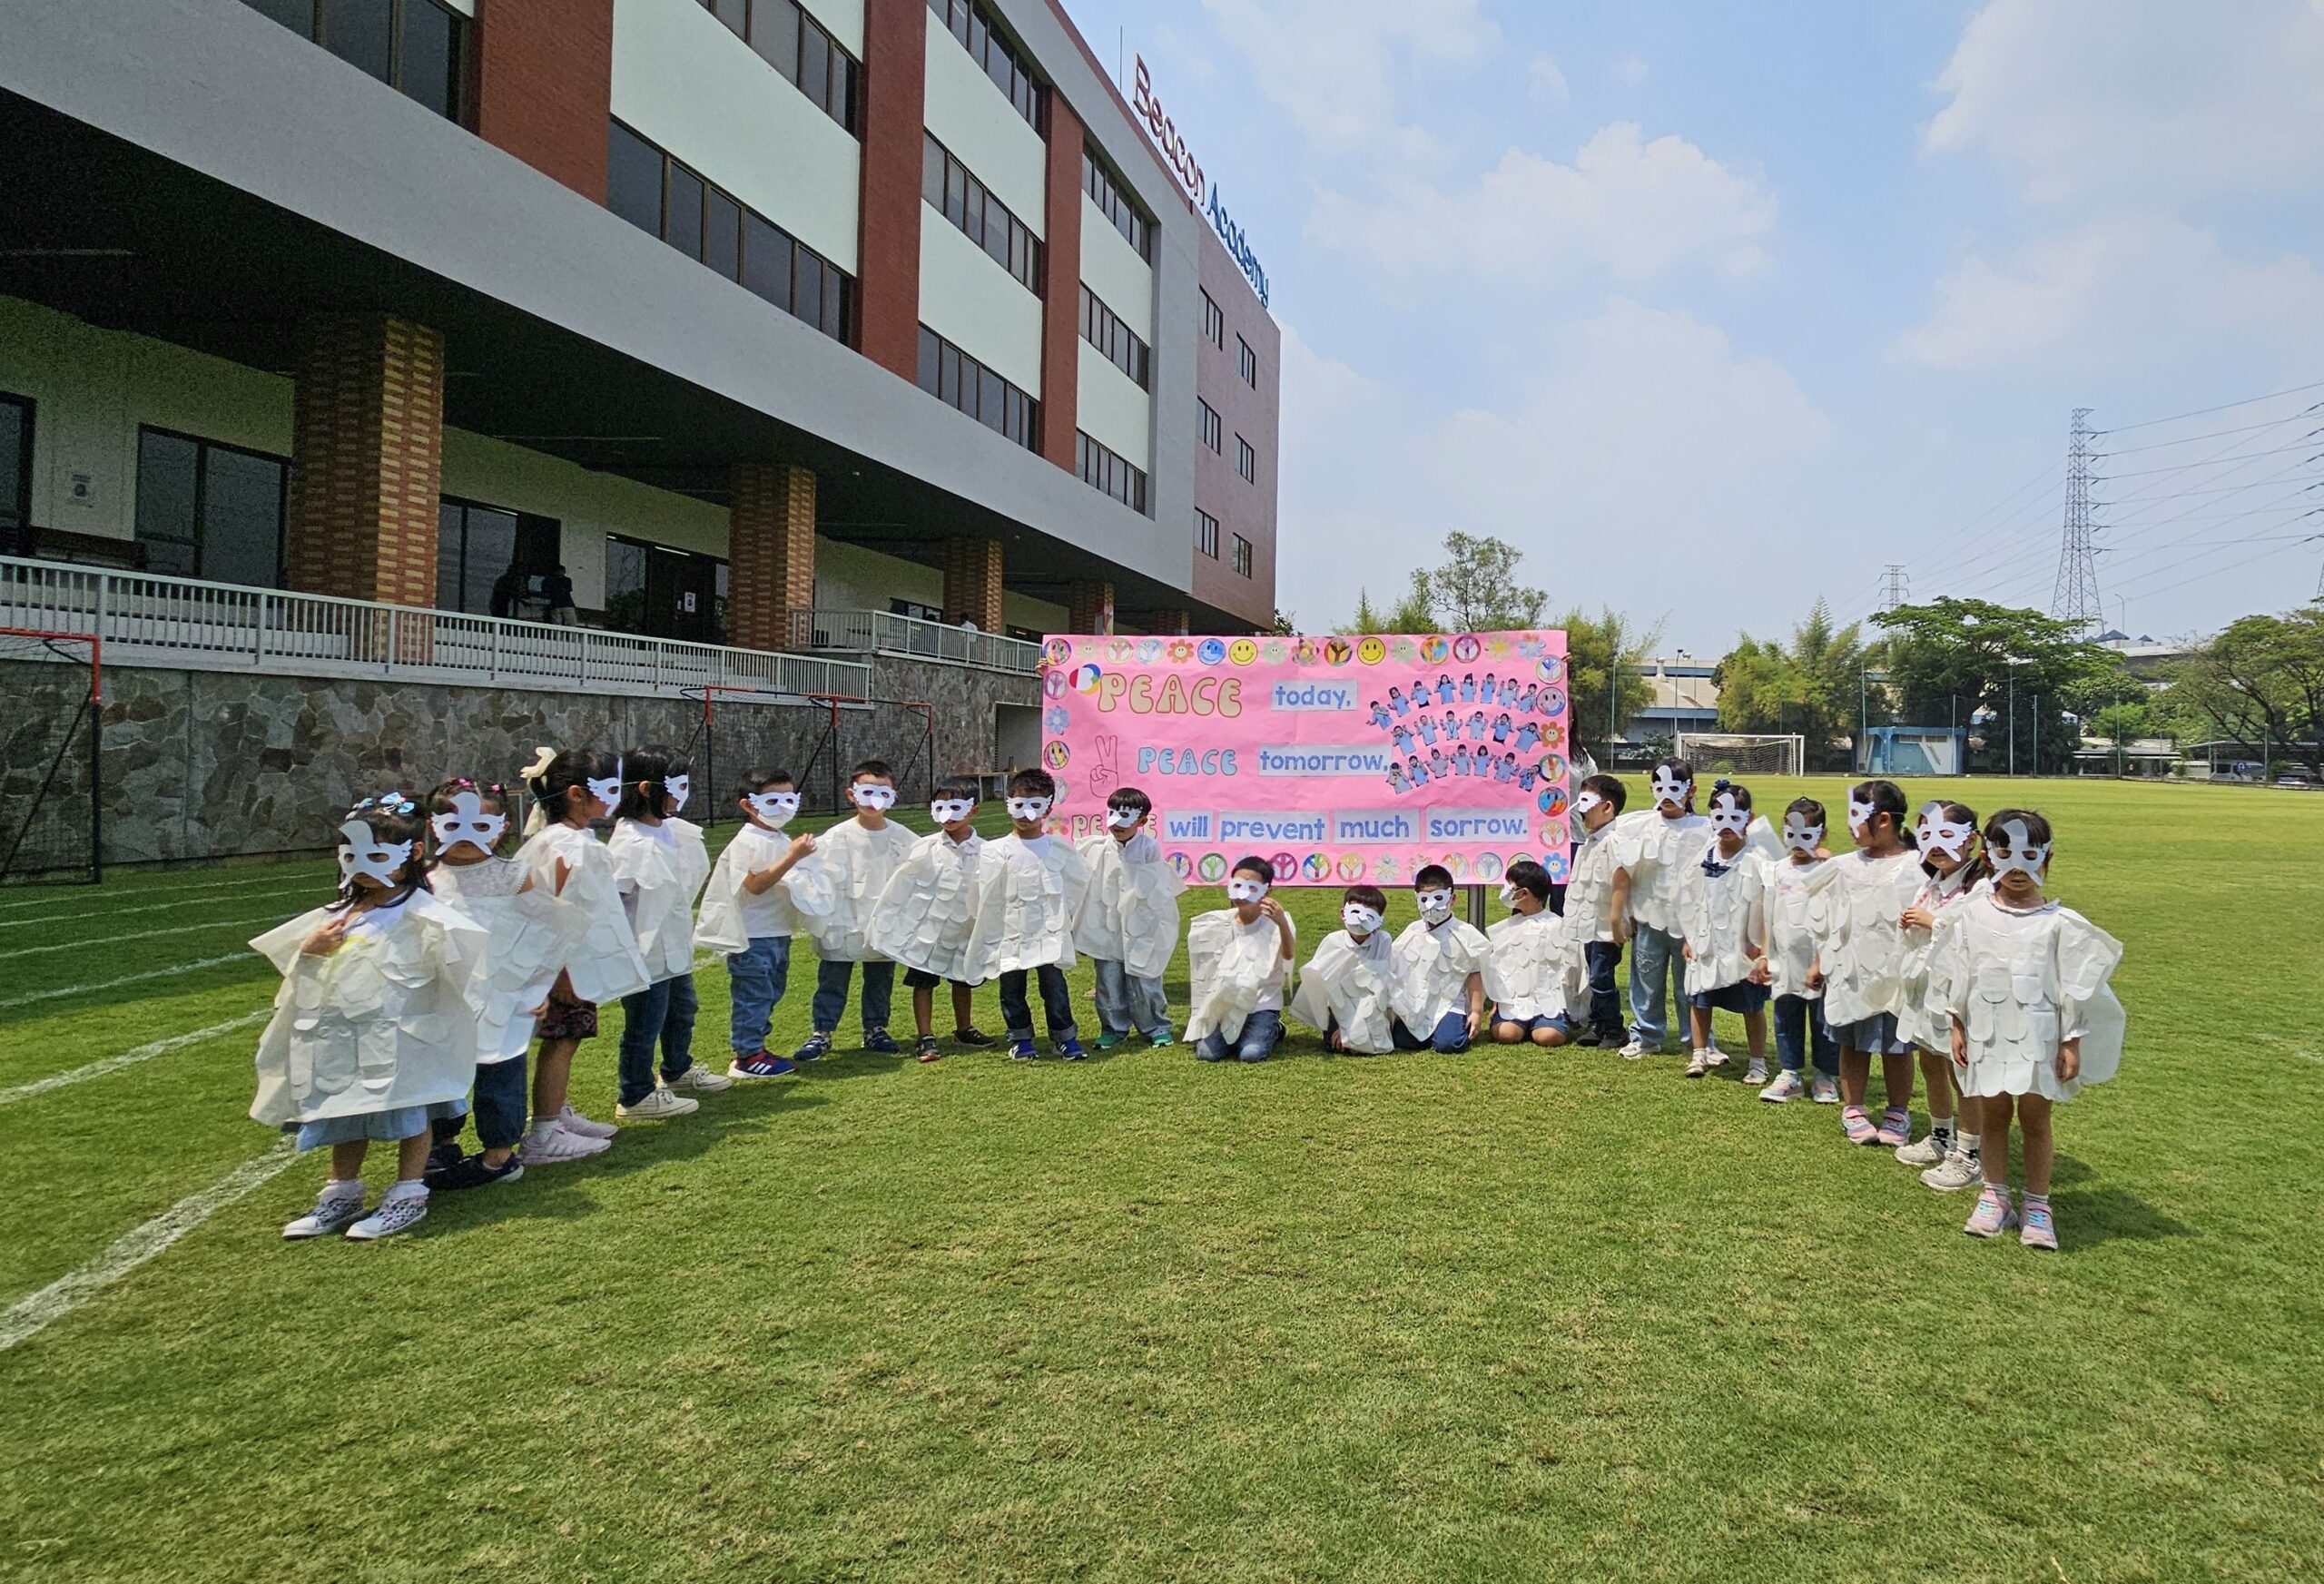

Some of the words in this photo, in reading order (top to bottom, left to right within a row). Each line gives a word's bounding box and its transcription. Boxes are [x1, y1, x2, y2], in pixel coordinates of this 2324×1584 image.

[1133, 52, 1206, 207] Beacon
[1206, 182, 1269, 310] Academy
[1097, 673, 1243, 718] PEACE
[1275, 685, 1351, 710] today,
[1137, 746, 1238, 776] PEACE
[1260, 751, 1389, 772] tomorrow,
[1071, 813, 1157, 841] PEE
[1169, 815, 1208, 837] will
[1220, 818, 1324, 842] prevent
[1340, 815, 1410, 838] much
[1430, 818, 1528, 837] sorrow.
